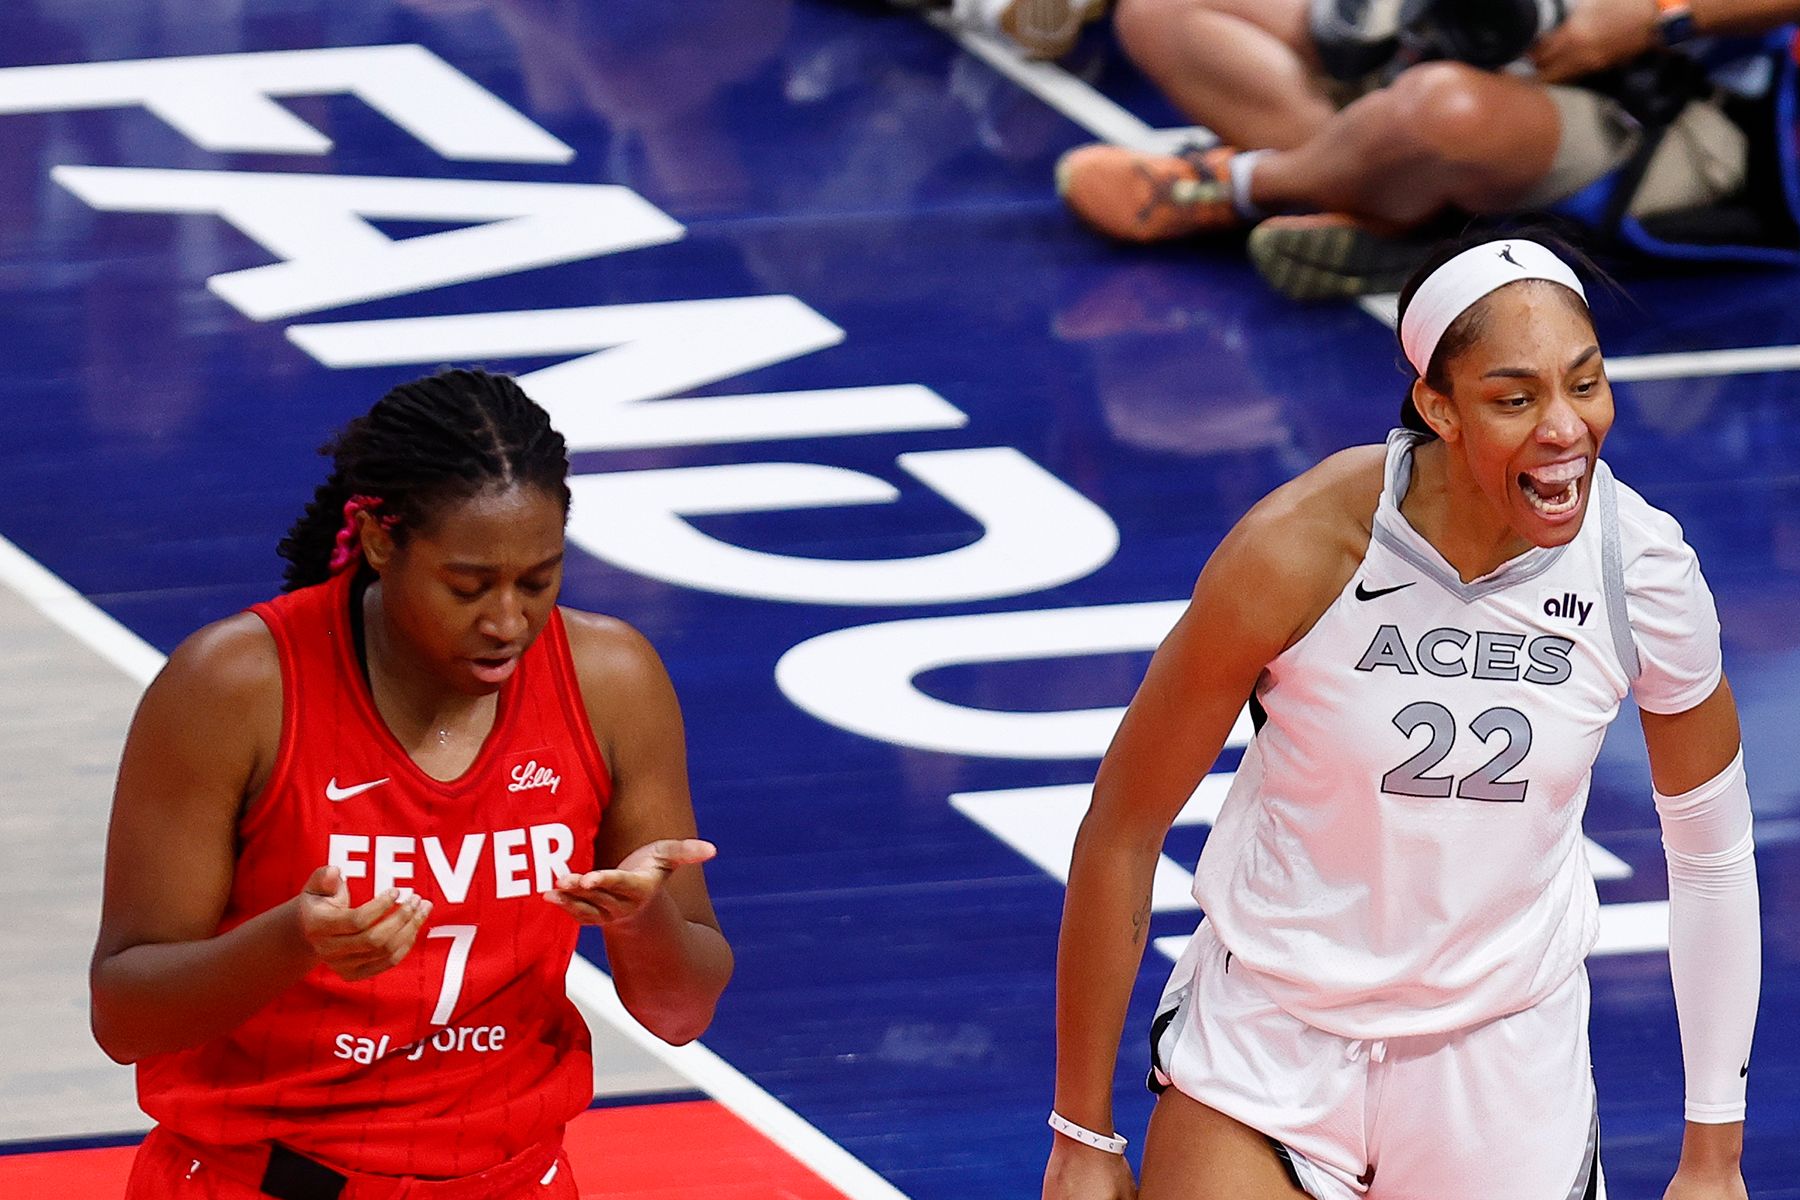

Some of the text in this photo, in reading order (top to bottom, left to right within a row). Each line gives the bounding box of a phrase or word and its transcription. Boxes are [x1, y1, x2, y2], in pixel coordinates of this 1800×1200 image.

[0, 44, 1672, 957] FANDU
[1543, 592, 1594, 626] ally
[1354, 624, 1576, 685] ACES
[507, 760, 561, 795] Lilly
[1380, 701, 1533, 802] 22
[327, 822, 575, 905] FEVER
[426, 923, 479, 1026] 7
[333, 1024, 506, 1065] salorce
